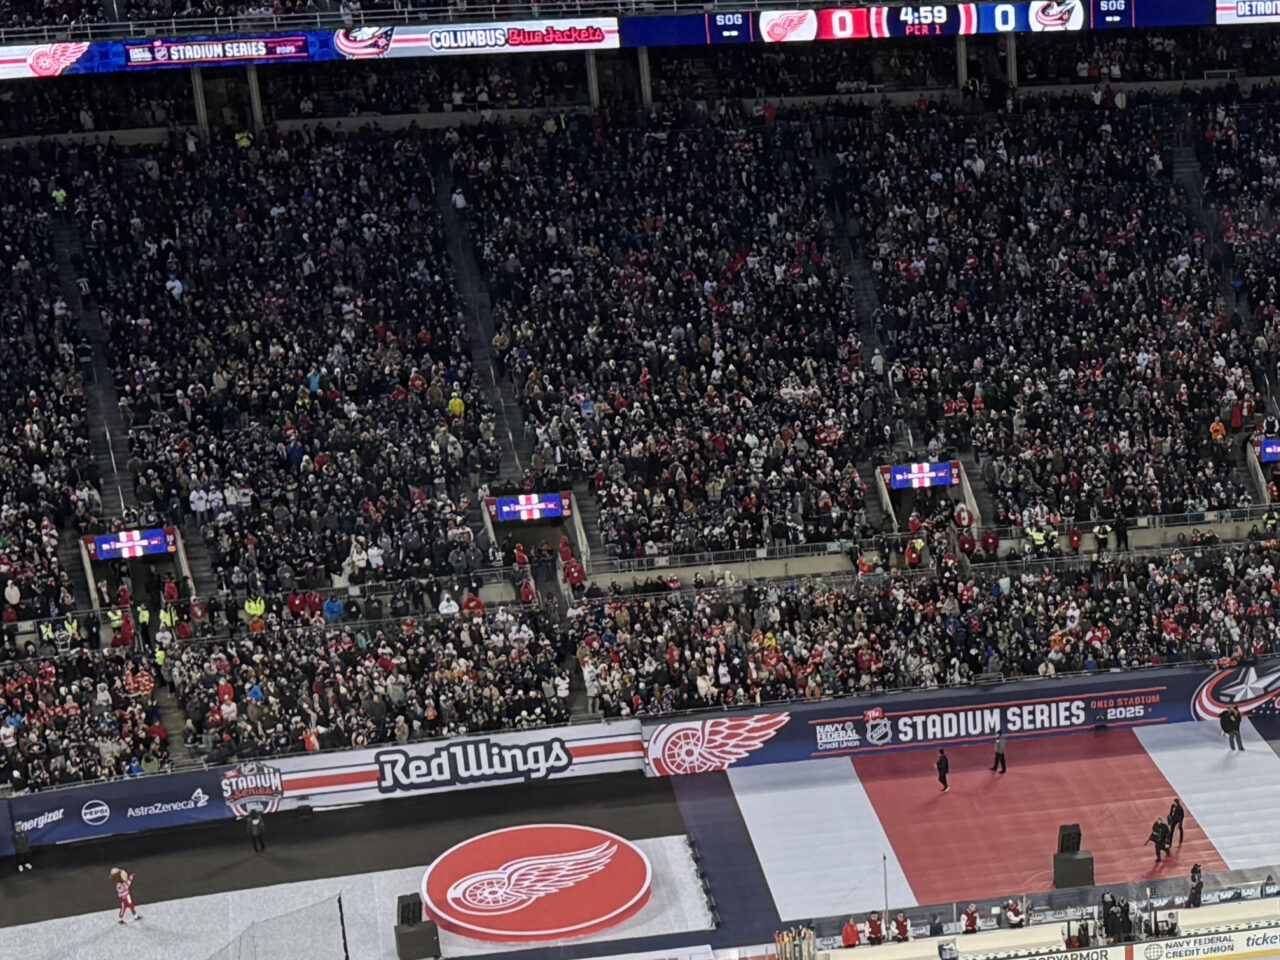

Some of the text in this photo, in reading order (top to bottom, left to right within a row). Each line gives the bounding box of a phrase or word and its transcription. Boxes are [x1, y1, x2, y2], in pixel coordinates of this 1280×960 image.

[1100, 0, 1125, 10] SOG
[716, 14, 742, 26] SOG
[832, 10, 853, 37] 0
[899, 6, 947, 25] 4:59
[994, 4, 1015, 31] 0
[431, 29, 505, 48] COLUMBUS
[170, 43, 224, 61] STADIUM
[225, 41, 267, 58] SERIES
[1091, 694, 1160, 709] OHIO STADIUM
[898, 700, 1086, 741] STADIUM SERIES
[1107, 706, 1144, 720] 2025
[816, 723, 843, 733] NAVY
[816, 729, 862, 740] FEDERAL
[379, 740, 569, 788] Red Wings
[221, 771, 282, 798] STADIUM
[127, 797, 195, 818] AstraZeneca
[1165, 935, 1234, 949] NAVY FEDERAL
[1165, 944, 1234, 959] CREDIT UNION
